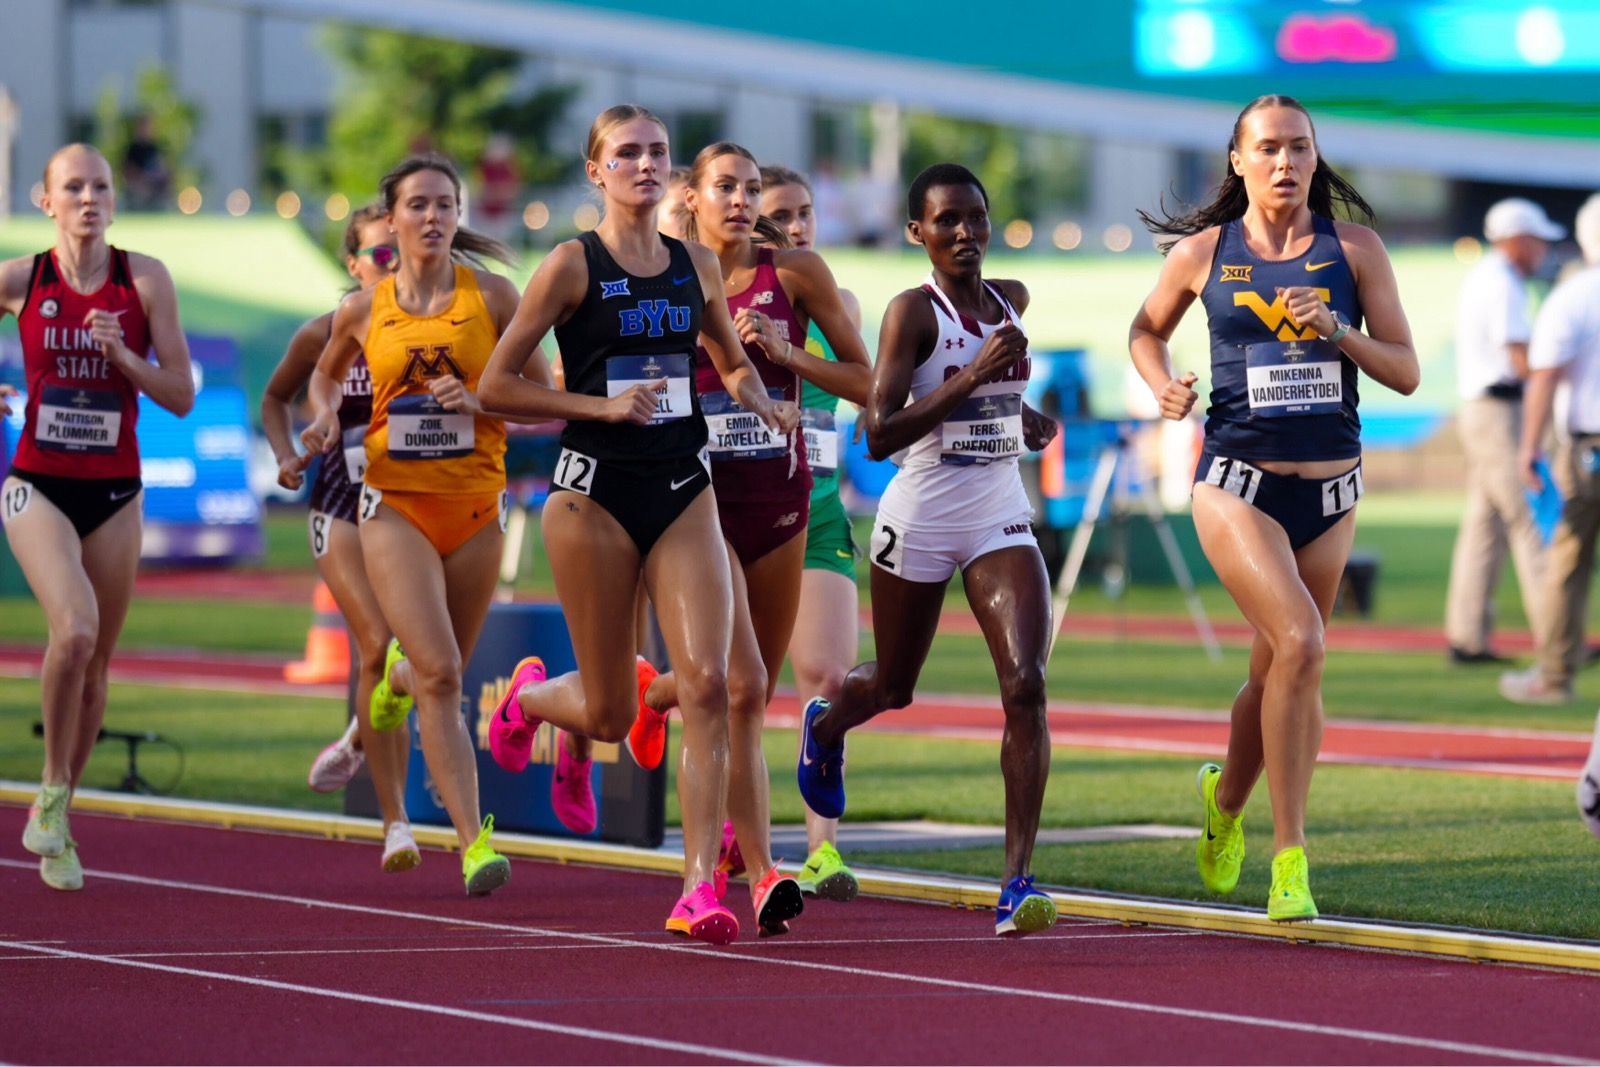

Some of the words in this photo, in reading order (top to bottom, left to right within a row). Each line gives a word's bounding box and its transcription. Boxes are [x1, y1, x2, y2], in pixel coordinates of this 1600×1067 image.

[619, 300, 690, 337] BYU
[44, 326, 125, 352] ILLIN
[57, 356, 109, 379] STATE
[401, 344, 467, 385] M
[1269, 367, 1323, 382] MIKENNA
[1251, 383, 1340, 404] VANDERHEYDEN
[54, 412, 104, 426] MATTISON
[419, 419, 443, 430] ZOIE
[726, 416, 760, 430] EMMA
[969, 423, 1006, 436] TERESA
[47, 423, 108, 442] PLUMMER
[404, 432, 458, 447] DUNDON
[716, 430, 771, 448] TAVELLA
[952, 436, 1019, 454] CHEROTICH
[559, 453, 592, 492] 12
[1219, 457, 1254, 498] 11
[5, 486, 28, 518] 10
[1327, 472, 1360, 511] 11
[313, 515, 327, 553] 8
[876, 525, 897, 570] 2
